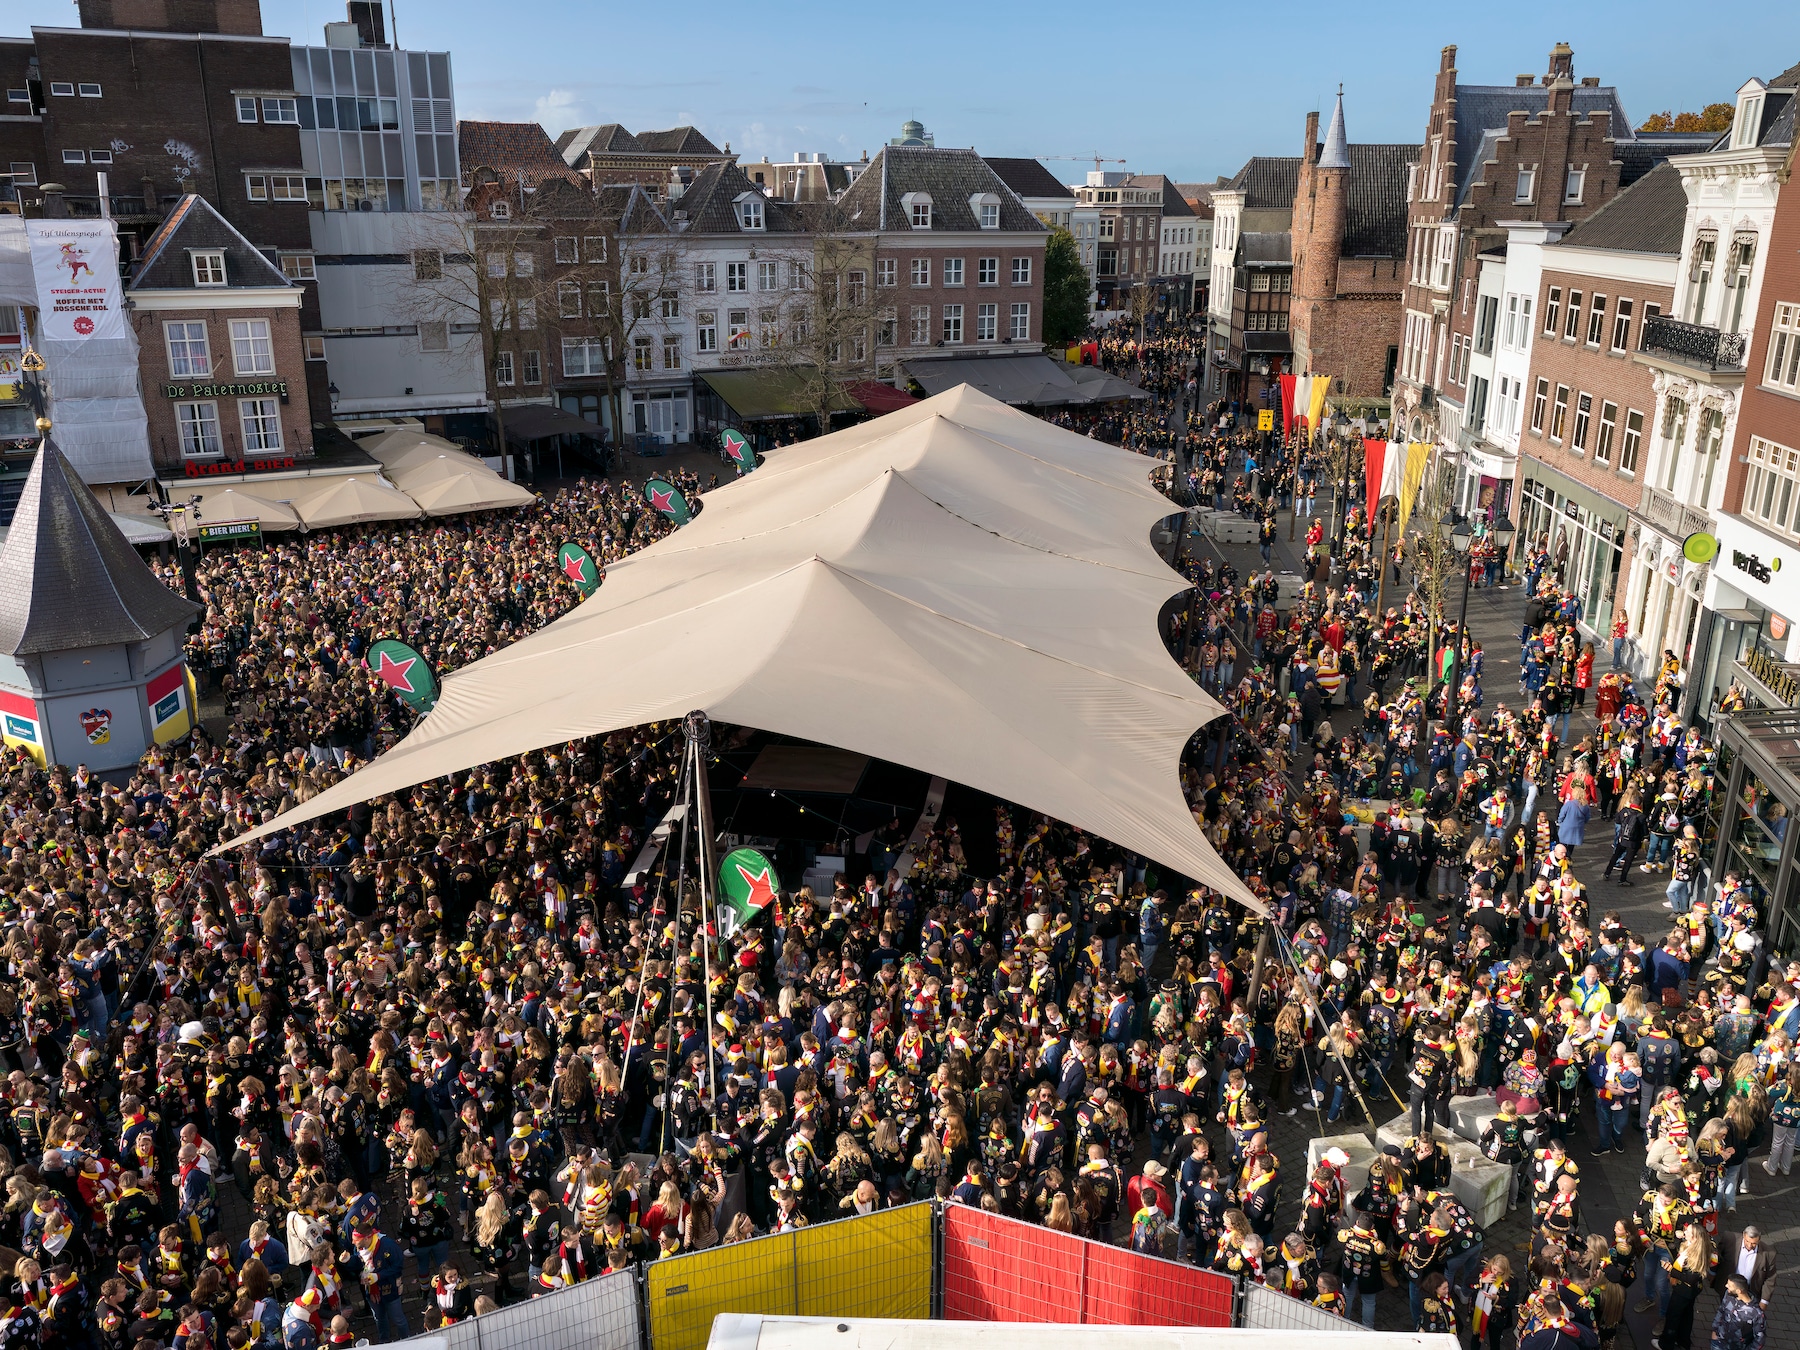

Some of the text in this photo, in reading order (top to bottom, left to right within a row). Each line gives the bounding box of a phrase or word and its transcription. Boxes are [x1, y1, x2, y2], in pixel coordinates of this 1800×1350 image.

[39, 229, 103, 238] Tijl Uilenspiegel
[50, 287, 107, 295] STEIGER-ACTIE!
[167, 381, 287, 398] De Paternoster
[185, 457, 295, 478] Brand BIER
[209, 525, 250, 536] BIER HIER!
[1732, 549, 1772, 585] veritas
[1745, 645, 1798, 705] BRASSERIE
